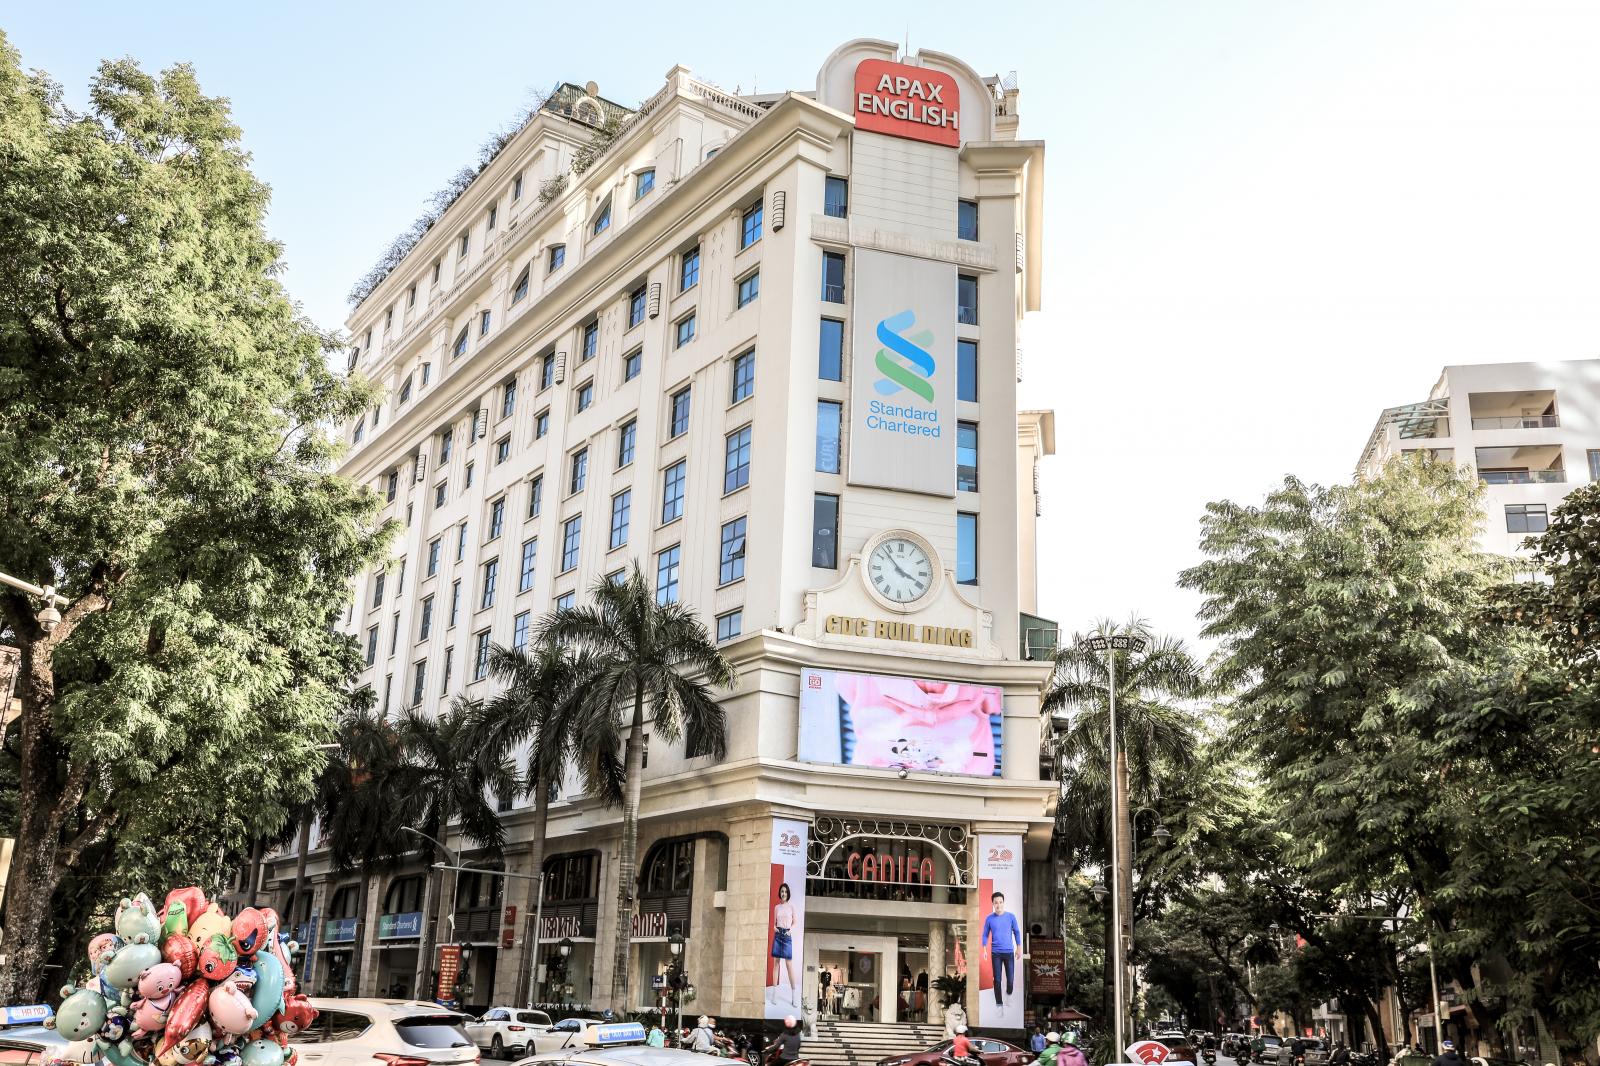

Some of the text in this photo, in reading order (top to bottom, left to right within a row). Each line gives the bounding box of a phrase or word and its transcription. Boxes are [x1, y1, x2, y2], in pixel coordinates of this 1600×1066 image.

[876, 74, 943, 104] APAX
[858, 92, 959, 130] ENGLISH
[866, 415, 940, 437] Chartered
[870, 400, 937, 422] Standard
[825, 614, 973, 648] CDC BUILDING
[847, 852, 935, 884] CANIFA
[632, 912, 668, 937] ANIFA
